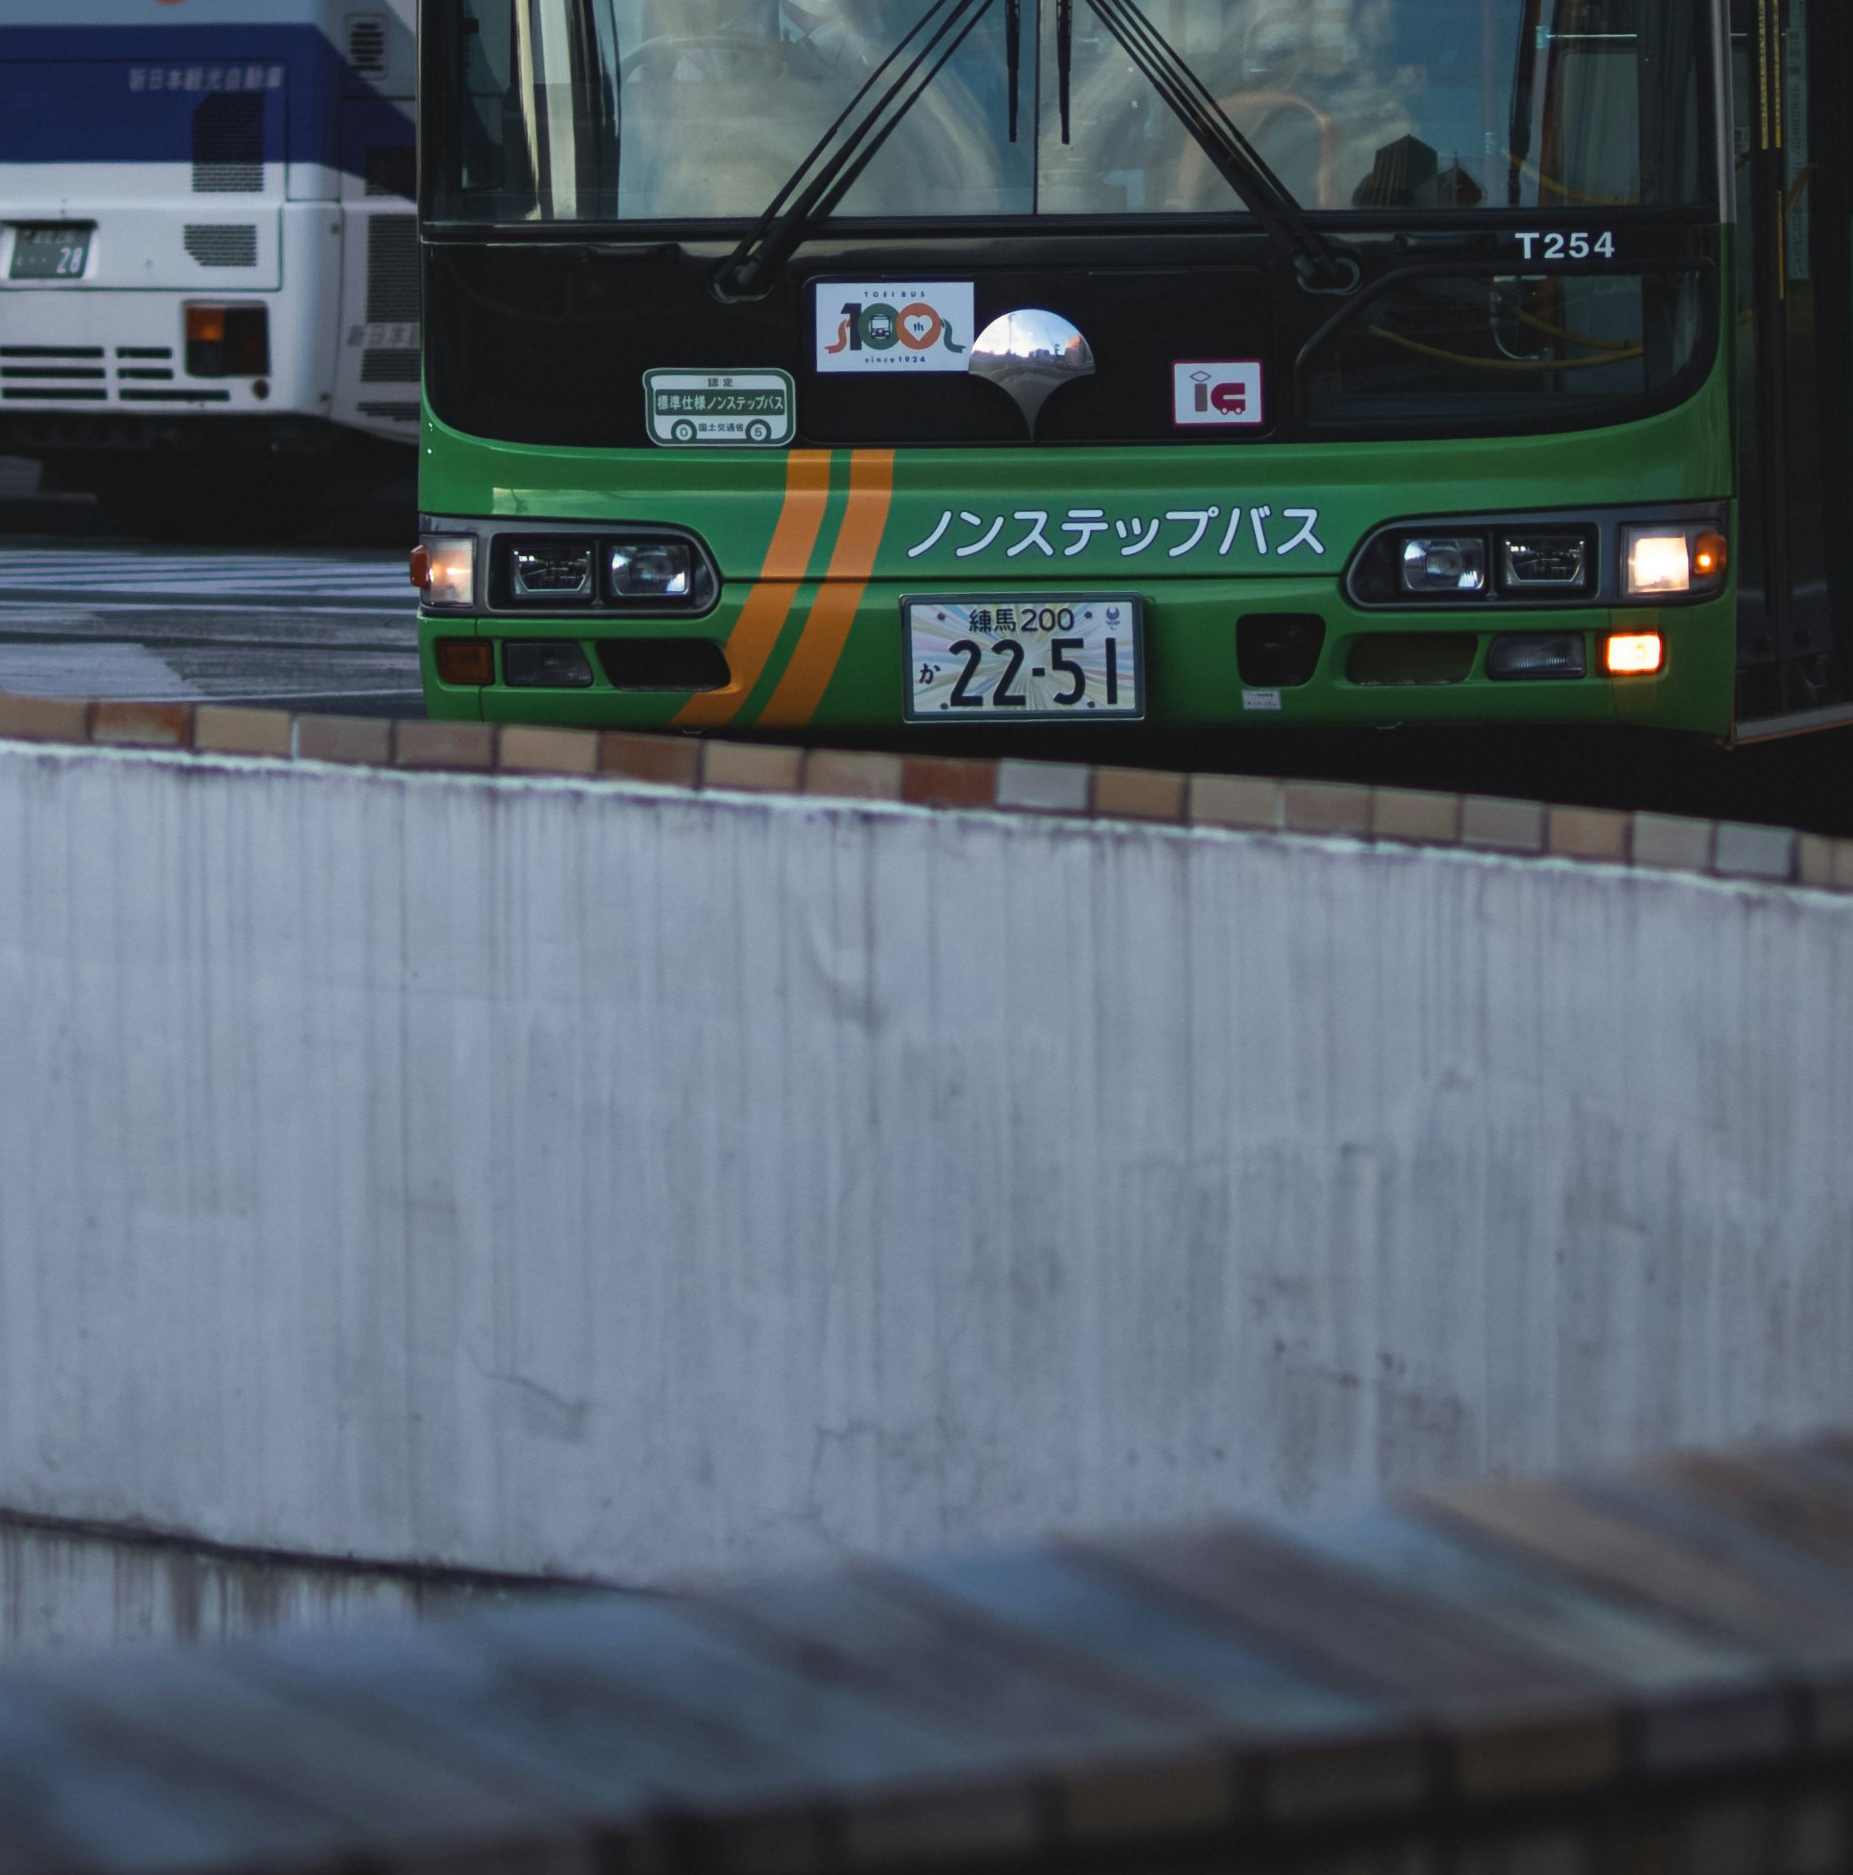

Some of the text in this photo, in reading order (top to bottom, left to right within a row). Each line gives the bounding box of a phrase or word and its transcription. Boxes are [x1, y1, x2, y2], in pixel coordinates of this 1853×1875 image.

[1514, 230, 1616, 260] T254
[864, 291, 926, 299] TOEI BUS
[840, 302, 942, 351] 100 th
[864, 355, 926, 364] since 1924
[657, 394, 784, 411] 標準仕様ノンステップバス
[679, 427, 689, 438] 0
[698, 422, 745, 433] 国土交通省
[753, 427, 763, 438] 5
[907, 504, 1326, 559] ノンステップバス
[918, 636, 1119, 708] か 22-51
